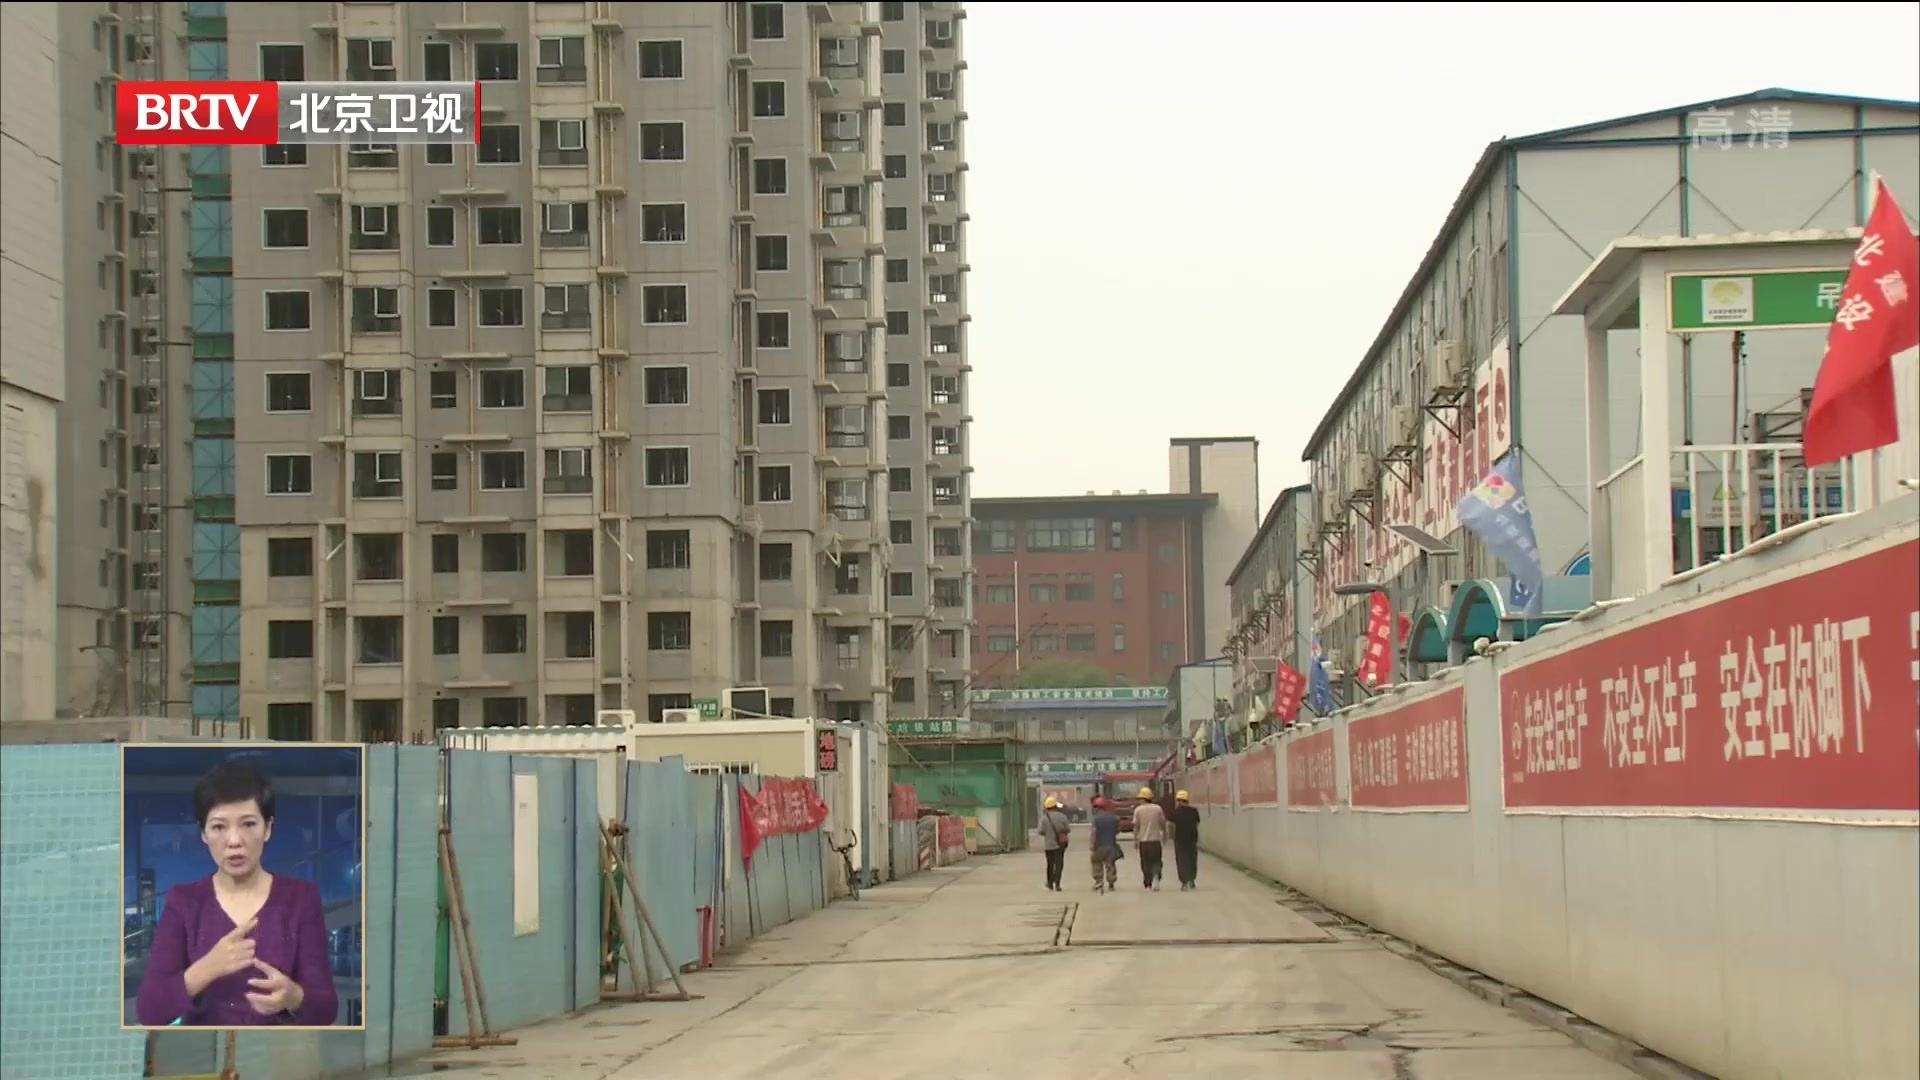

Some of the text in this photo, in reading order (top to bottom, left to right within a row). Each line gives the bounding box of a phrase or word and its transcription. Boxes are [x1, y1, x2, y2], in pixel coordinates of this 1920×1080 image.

[1817, 282, 1849, 310] 吊
[1601, 650, 1697, 768] 不安全不生产
[1719, 615, 1872, 761] 安全在你脚下
